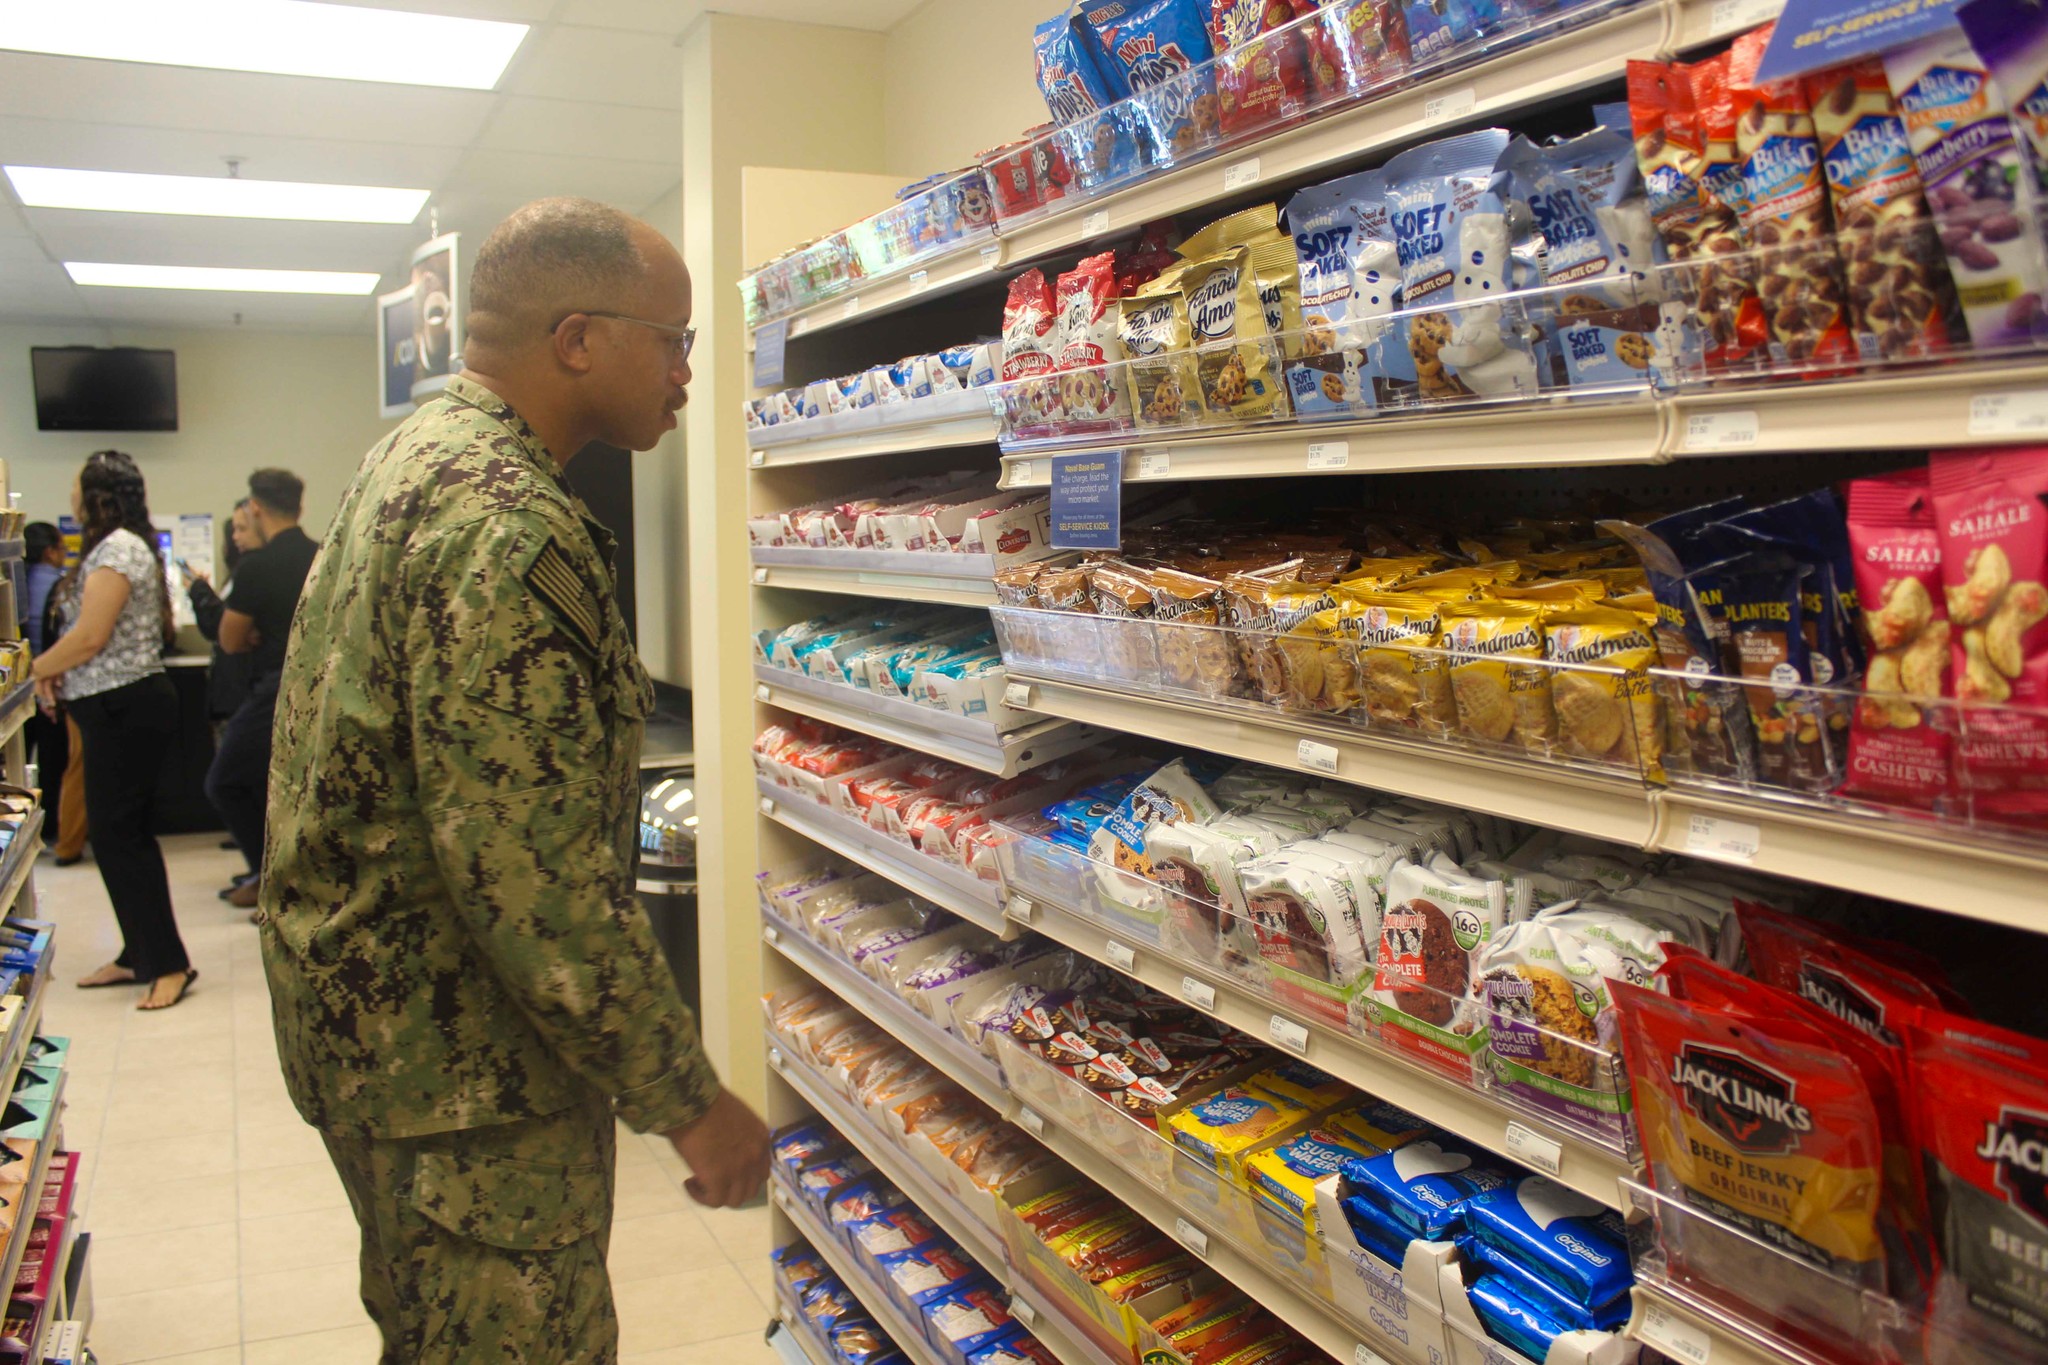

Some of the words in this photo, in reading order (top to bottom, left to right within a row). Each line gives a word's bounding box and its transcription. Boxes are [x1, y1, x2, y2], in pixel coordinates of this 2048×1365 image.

[1117, 32, 1157, 67] Mini
[1918, 70, 1959, 92] BLUE
[1901, 76, 1980, 113] DIAMOND
[1842, 118, 1897, 156] BLUE
[1752, 139, 1792, 174] BLUE
[1823, 139, 1908, 183] DIAMON
[1700, 164, 1742, 193] BLUE
[1399, 191, 1435, 210] mini
[1528, 188, 1584, 228] SOFT
[1303, 214, 1334, 232] mini
[1391, 202, 1447, 240] SOFT
[1543, 215, 1596, 248] BAKED
[1296, 226, 1353, 261] SOFT
[1585, 258, 1607, 275] CHIP
[1434, 273, 1453, 288] CHIP
[1301, 290, 1334, 306] OCOLATE
[1567, 328, 1601, 349] SOFT
[1572, 343, 1606, 361] BAKED
[1291, 368, 1314, 387] SOFT
[1293, 380, 1317, 396] BAKED
[1061, 475, 1071, 484] Take
[1089, 473, 1100, 481] lead
[1100, 472, 1110, 481] the
[1064, 463, 1079, 473] Naval
[1079, 463, 1091, 472] Base
[1090, 462, 1105, 471] Guam
[1060, 486, 1070, 495] way
[1070, 484, 1079, 493] and
[1079, 484, 1097, 494] protect
[1097, 483, 1110, 494] your
[1067, 496, 1081, 504] micro
[1059, 522, 1094, 531] SELF-SERVICE
[1093, 521, 1110, 531] KIOSK
[1948, 504, 2032, 538] SAHALE
[1657, 601, 1686, 628] NTERS
[1355, 611, 1441, 653] Grandma'
[1442, 624, 1540, 670] Grandma's
[1545, 628, 1652, 678] Grandma's
[1853, 756, 1949, 786] CASHEWS
[1110, 822, 1138, 847] COOKIE
[1421, 884, 1459, 904] PLANT-BASED
[1455, 915, 1479, 935] 16G
[1584, 926, 1625, 949] ANT-BASED
[1529, 947, 1557, 961] PLANT
[1798, 970, 1838, 1017] JACK
[1418, 1039, 1439, 1055] DOUBLE
[1496, 1041, 1532, 1056] COOKIE
[1528, 1074, 1578, 1100] PLANT-BASED
[1671, 1055, 1732, 1105] JACK
[1731, 1078, 1813, 1132] LINK'S
[1203, 1105, 1251, 1122] WAFERS
[1213, 1100, 1259, 1116] SUGAR
[1565, 1103, 1598, 1121] OATMEAL
[1689, 1138, 1735, 1171] BEEF
[1738, 1160, 1808, 1197] JERKY
[1261, 1176, 1283, 1197] SUGAR
[1709, 1170, 1792, 1215] ORIGINAL
[1038, 1202, 1065, 1217] Peanut
[1097, 1241, 1122, 1256] Peanut
[1556, 1233, 1610, 1267] Original
[1140, 1274, 1167, 1289] Peanut
[1364, 1281, 1409, 1321] TREATS
[1369, 1306, 1409, 1346] Original
